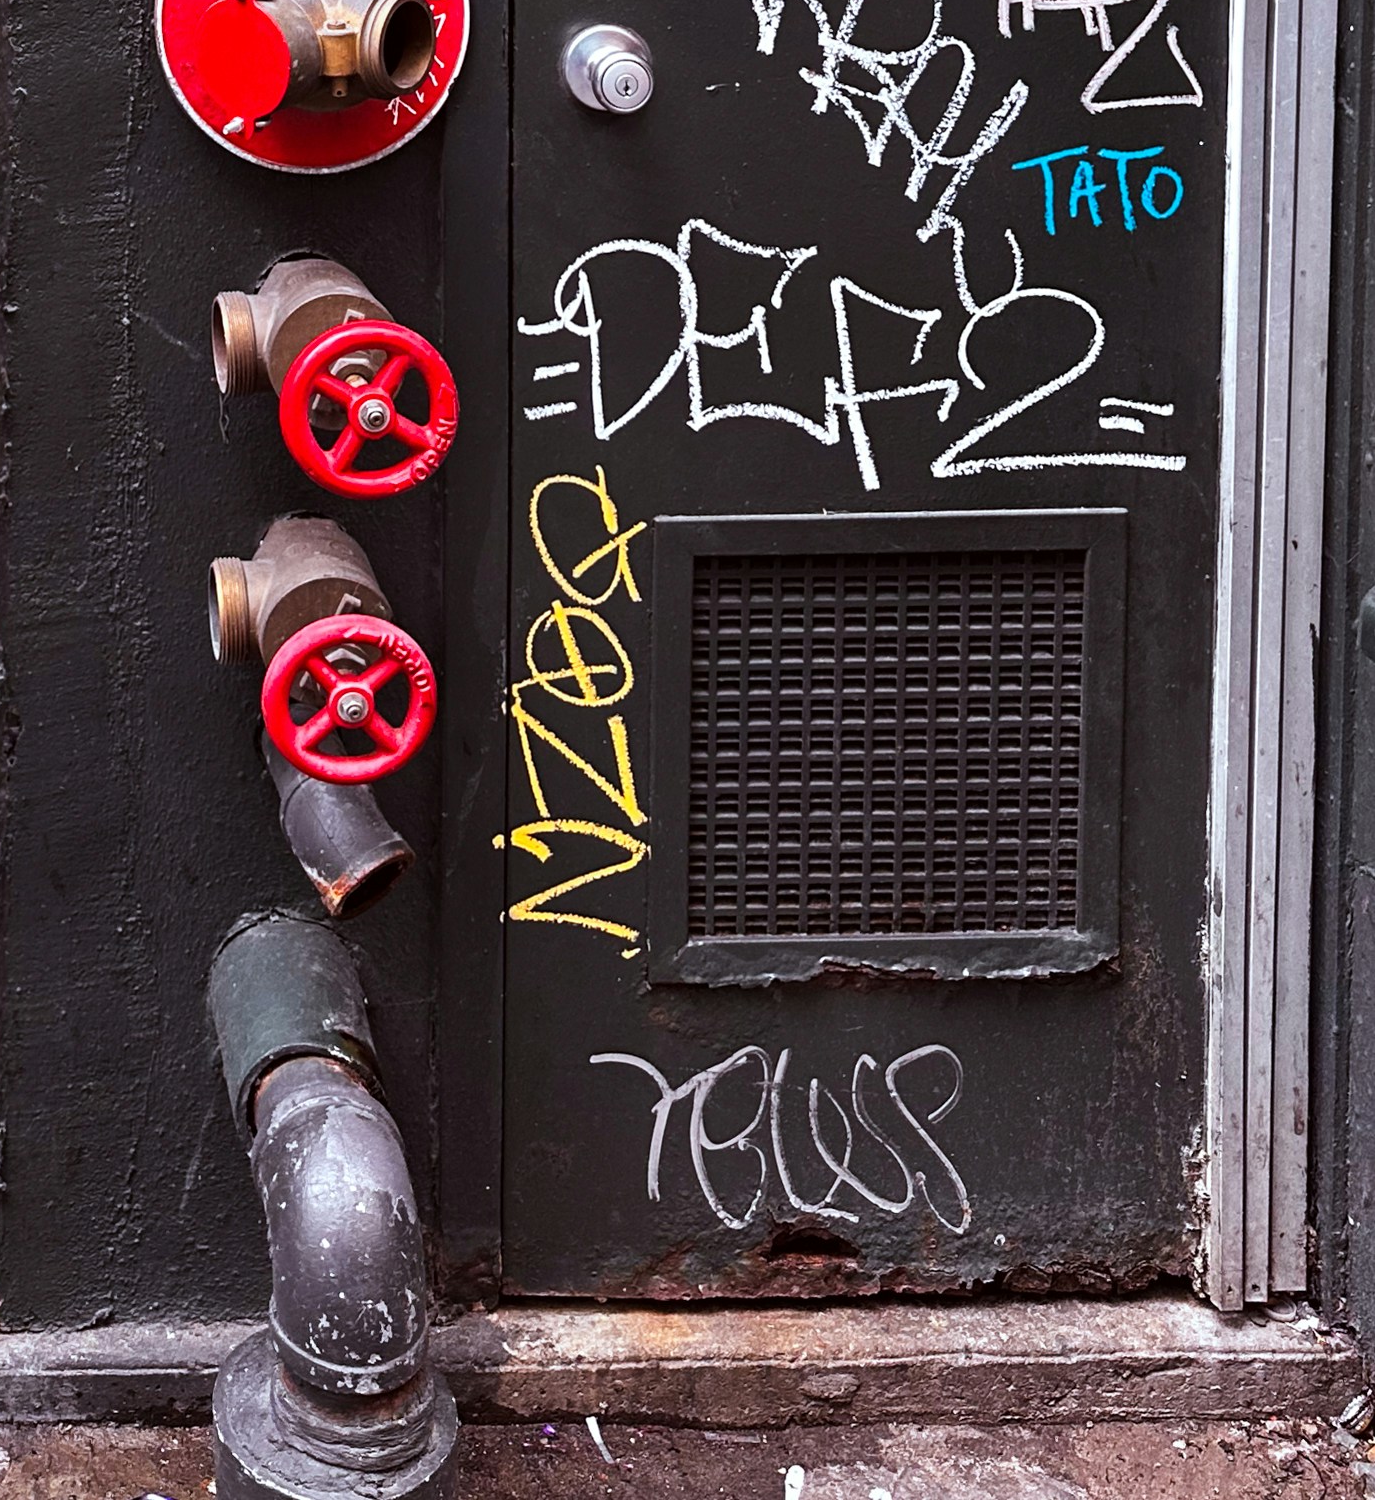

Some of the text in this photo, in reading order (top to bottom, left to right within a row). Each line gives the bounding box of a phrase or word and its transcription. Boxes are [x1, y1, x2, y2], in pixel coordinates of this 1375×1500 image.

[1012, 145, 1186, 236] TATO
[410, 416, 457, 483] OPEN
[378, 630, 432, 694] OPEN
